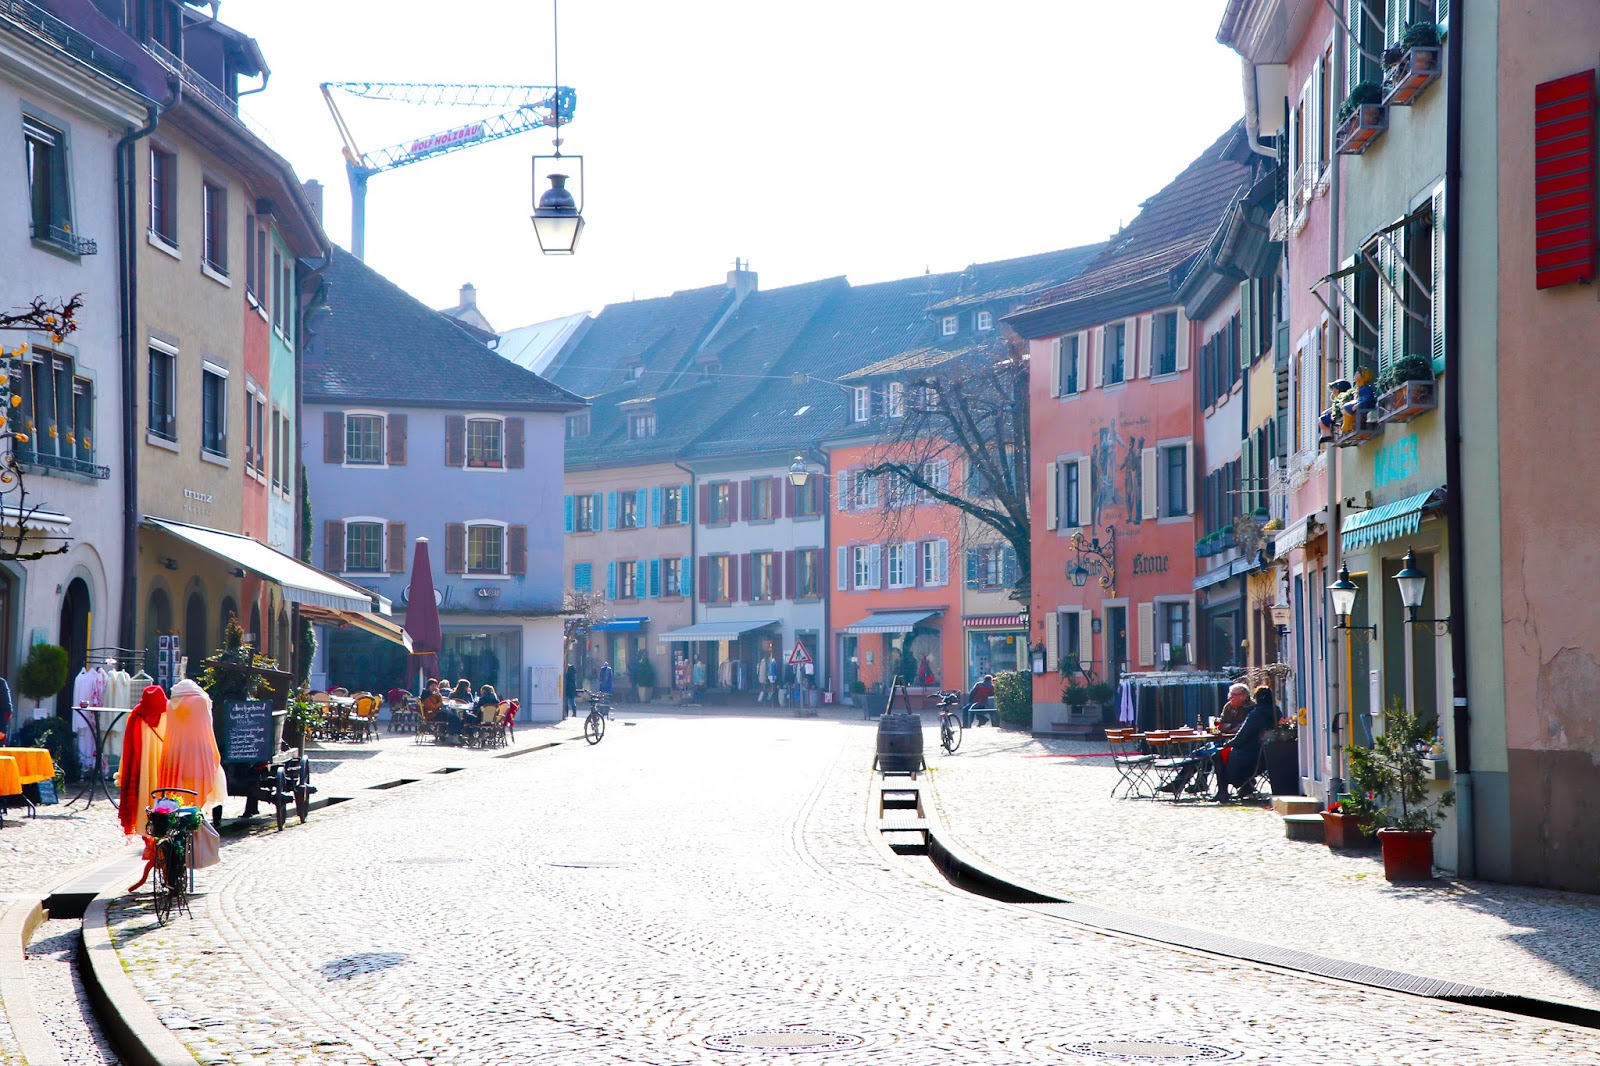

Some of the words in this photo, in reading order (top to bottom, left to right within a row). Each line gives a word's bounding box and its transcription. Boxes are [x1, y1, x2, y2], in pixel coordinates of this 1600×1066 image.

[411, 139, 433, 153] WOLF
[434, 124, 479, 146] HOLZBAU
[1373, 432, 1419, 489] MAIER
[183, 488, 213, 504] trunz
[1132, 552, 1169, 575] Krone
